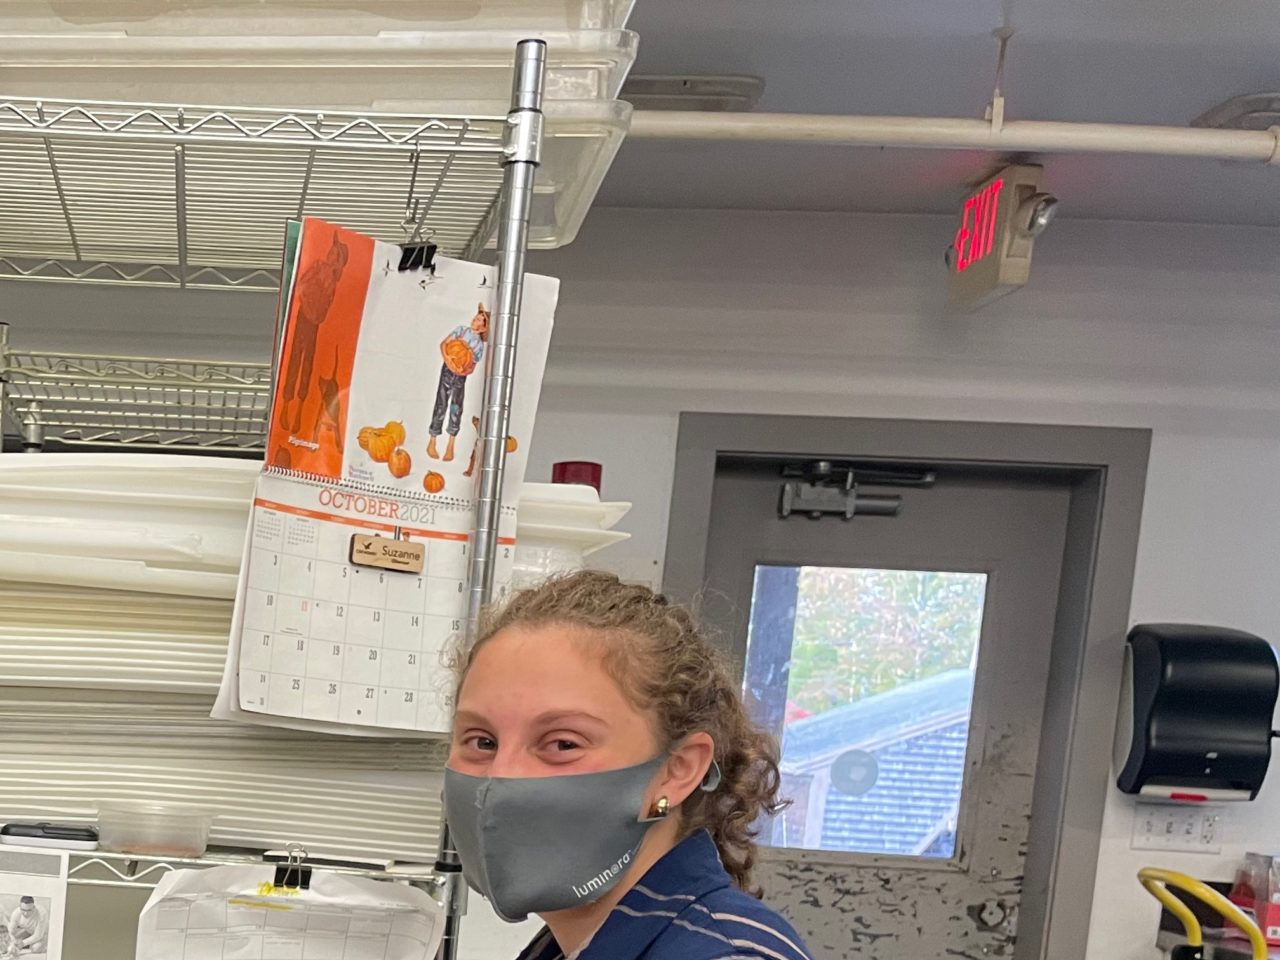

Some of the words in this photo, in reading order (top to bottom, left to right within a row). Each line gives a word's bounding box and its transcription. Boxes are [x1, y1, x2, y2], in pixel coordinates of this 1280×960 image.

[318, 487, 401, 520] OCTOBER
[400, 503, 437, 525] 2021
[382, 545, 421, 561] Suzanne
[503, 547, 510, 559] 2
[342, 566, 348, 578] 5
[336, 605, 344, 617] 12
[411, 616, 419, 627] 14
[451, 620, 460, 631] 15
[368, 649, 378, 660] 20
[407, 653, 416, 665] 21
[291, 678, 300, 690] 25
[365, 688, 375, 699] 27
